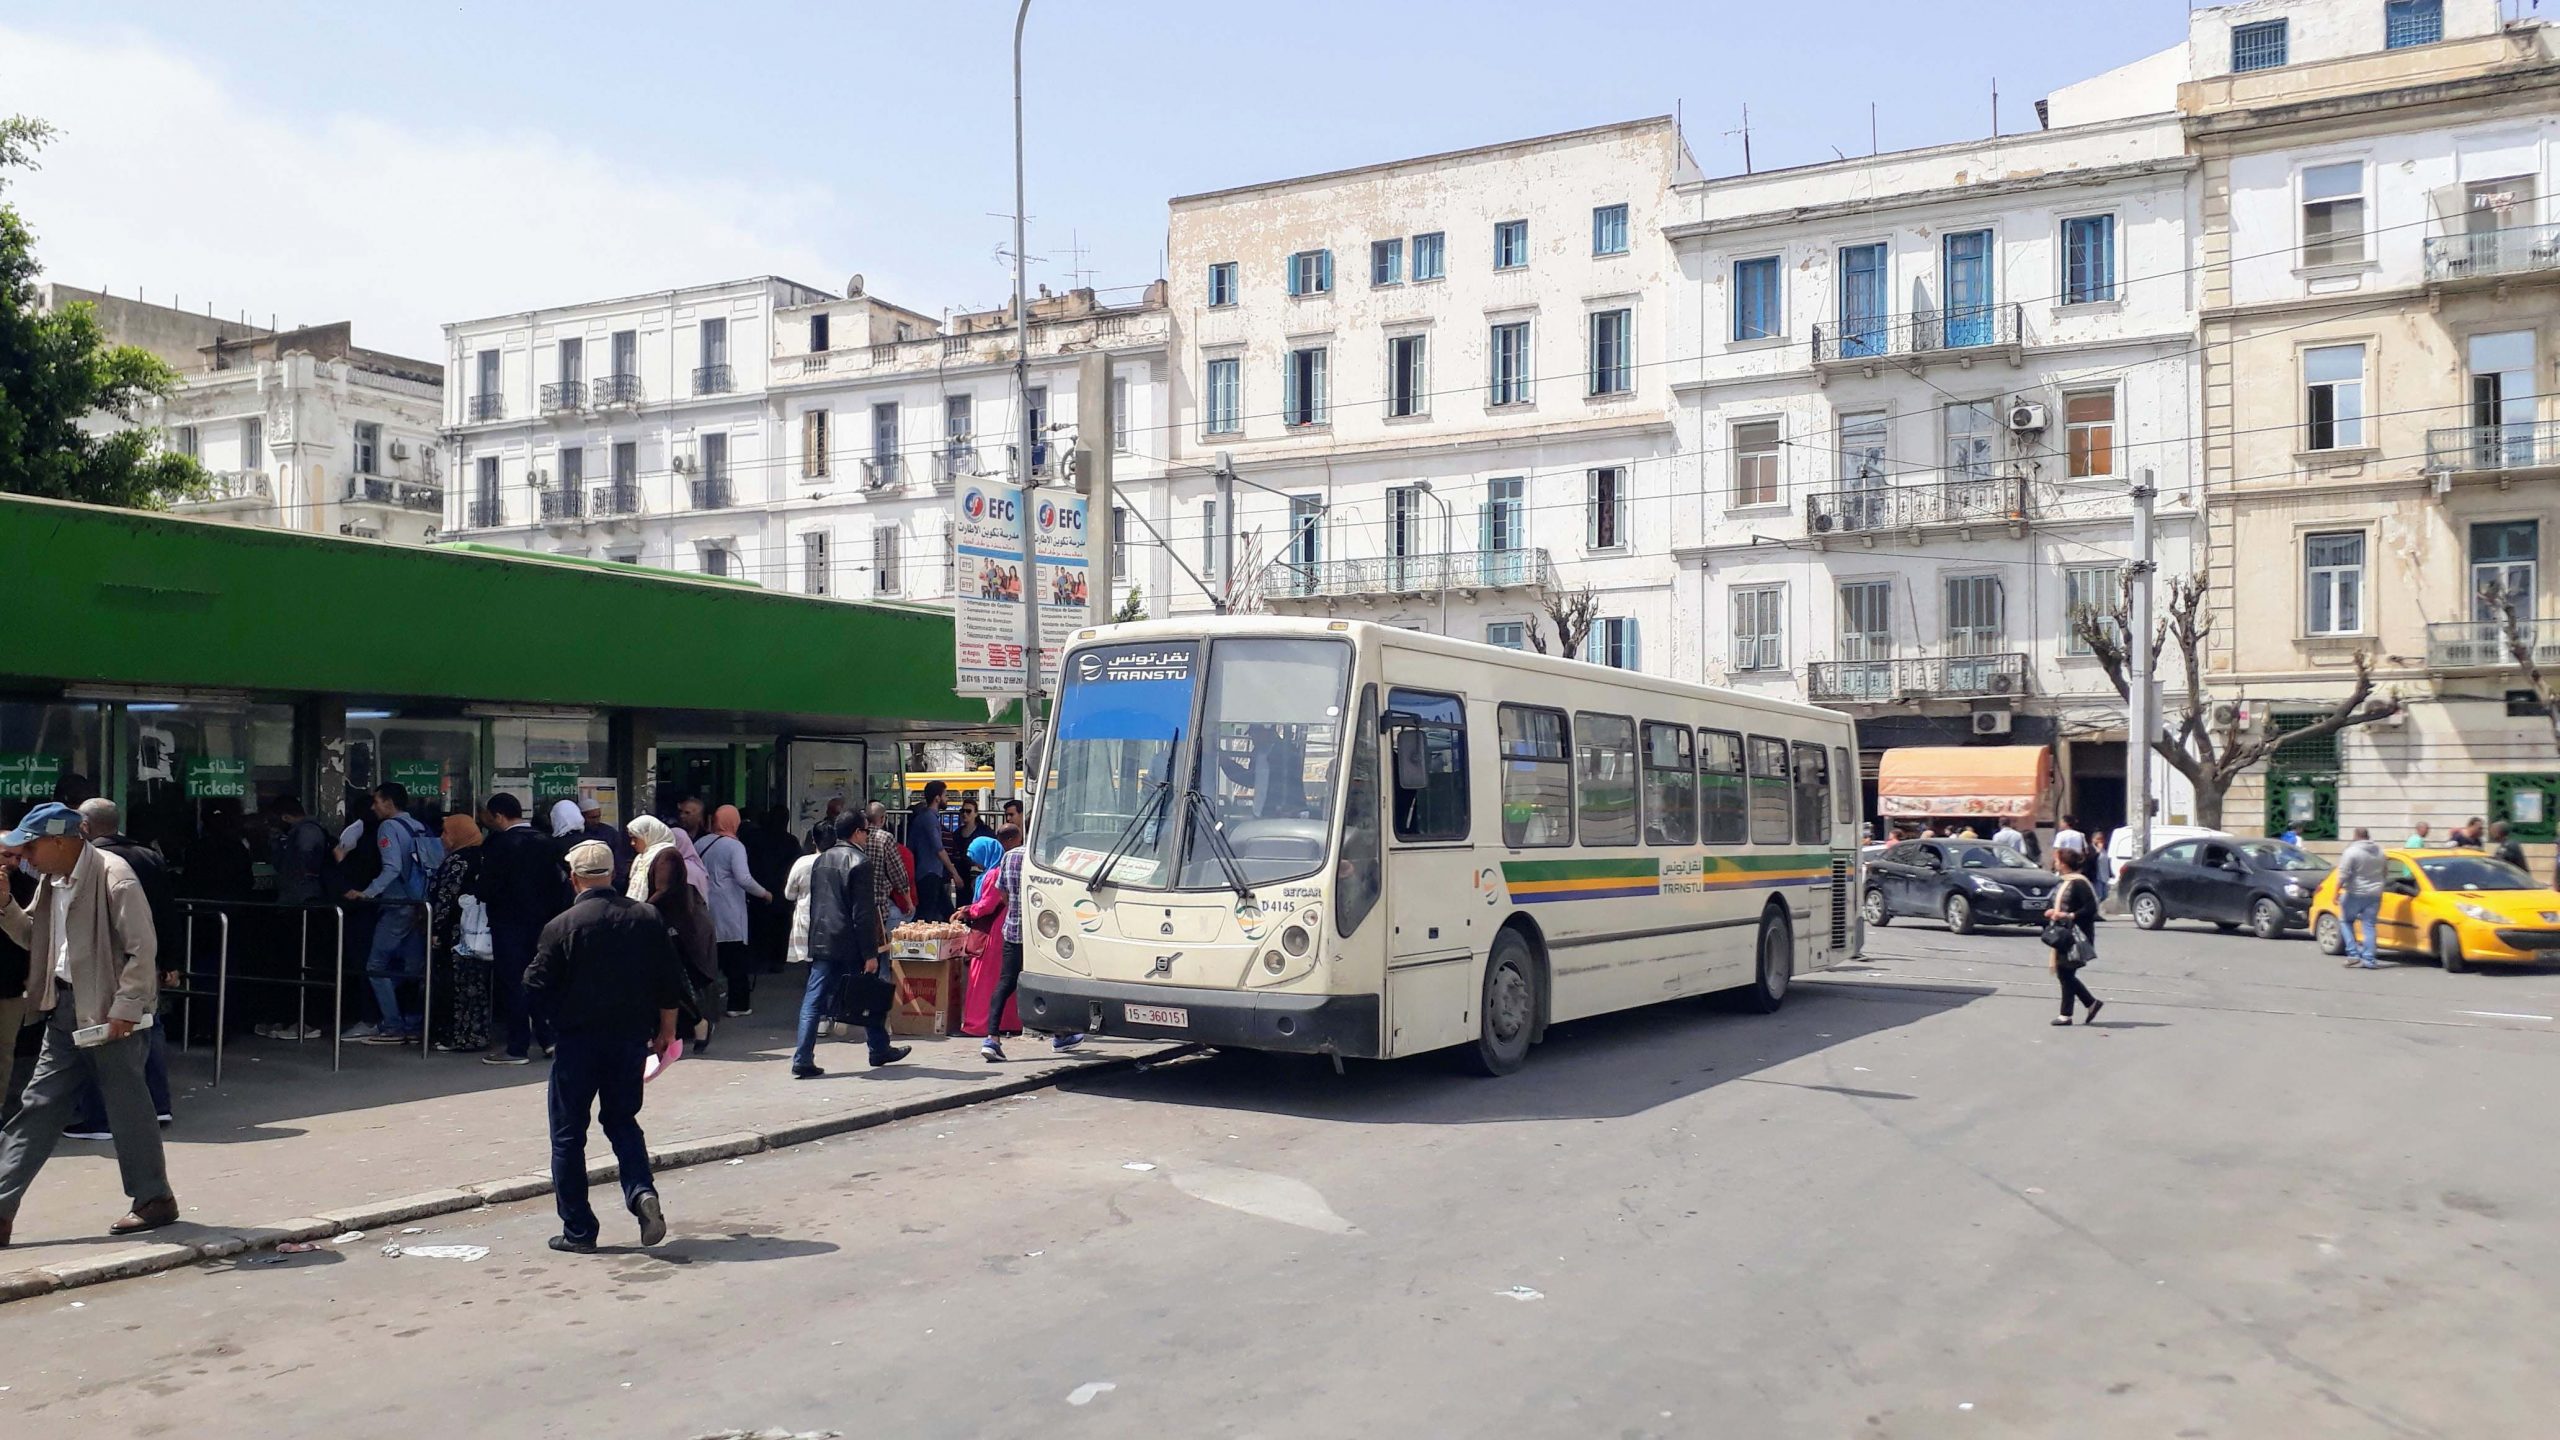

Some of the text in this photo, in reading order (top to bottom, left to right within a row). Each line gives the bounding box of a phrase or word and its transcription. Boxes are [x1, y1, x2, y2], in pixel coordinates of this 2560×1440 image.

[989, 497, 1015, 522] EFC
[1059, 507, 1082, 530] EFC
[981, 526, 1001, 539] تكوين
[1000, 527, 1020, 541] مدرسة
[1052, 536, 1069, 548] تكوين
[1069, 535, 1086, 549] مدرسة
[1108, 651, 1190, 666] نقل تونس
[1107, 669, 1187, 681] TRANSTU
[189, 759, 245, 776] تذاكر
[394, 763, 439, 778] تذاكر
[540, 764, 580, 778] تذاكر
[189, 780, 245, 796] Tickets
[539, 781, 578, 796] Tickets
[1662, 860, 1702, 876] نقل تونس
[1029, 874, 1064, 886] VOLVO
[1283, 887, 1322, 898] SETCAR
[1663, 882, 1702, 895] TRANSTU
